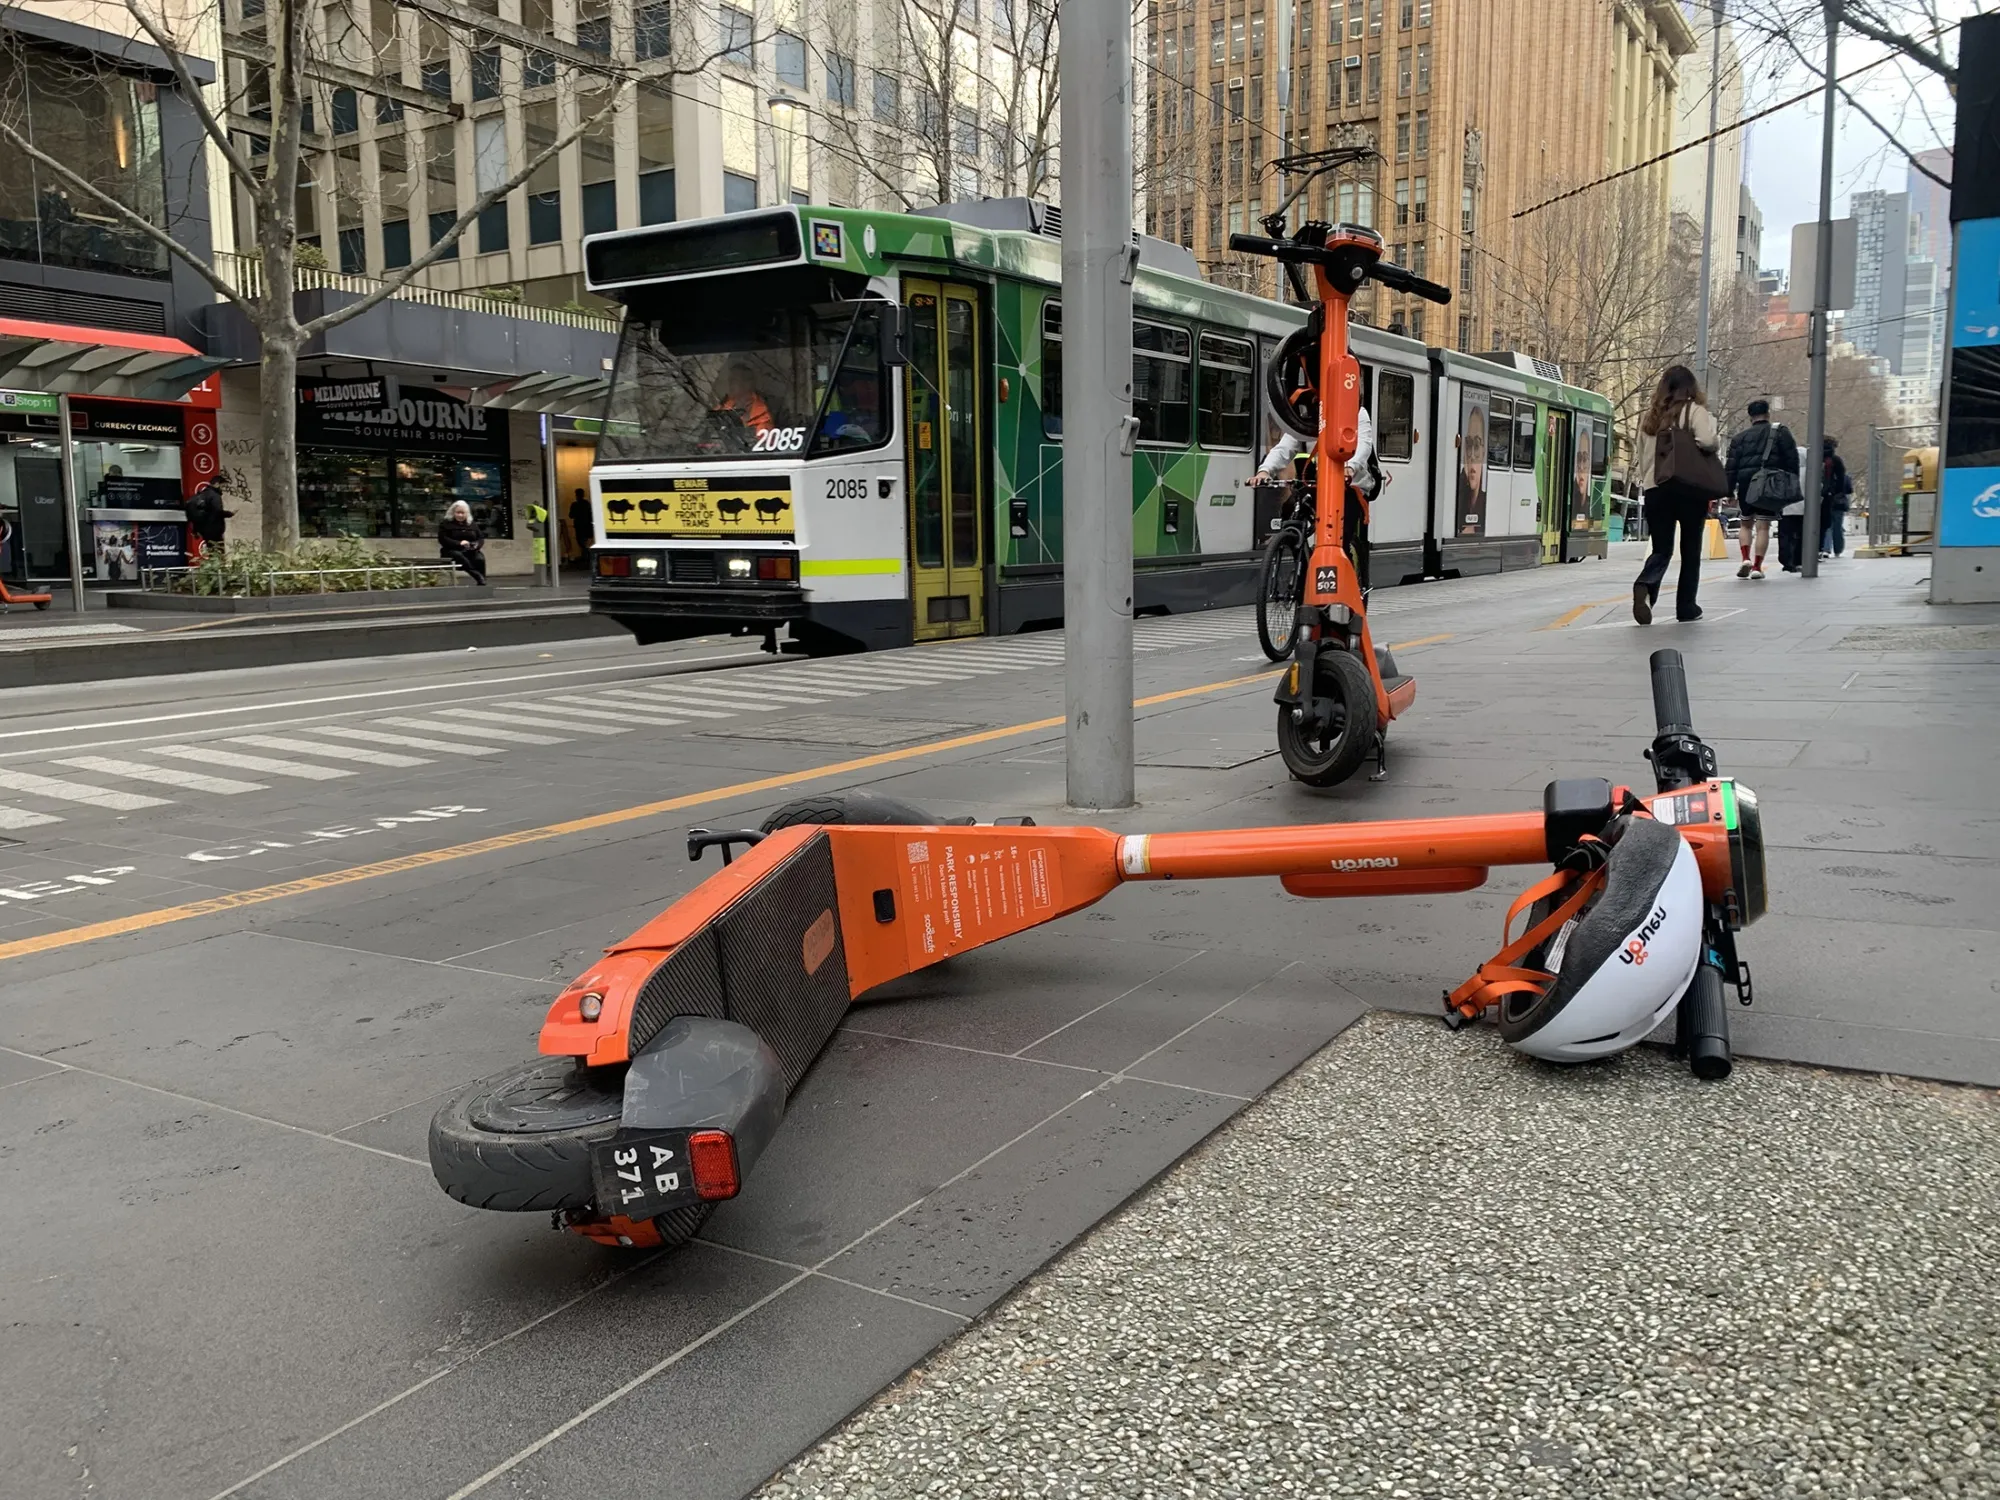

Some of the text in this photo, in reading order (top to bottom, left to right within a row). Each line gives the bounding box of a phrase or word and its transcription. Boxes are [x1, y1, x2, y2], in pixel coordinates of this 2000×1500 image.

[314, 382, 381, 402] MELBOURNE
[17, 396, 52, 407] Stop 11
[322, 398, 487, 431] LBOURNE
[94, 421, 178, 433] CURRENCY EXCHANGE
[354, 426, 462, 441] SOUVENIR SHOP
[752, 427, 806, 452] 2085
[673, 479, 709, 488] BEWARE
[826, 479, 867, 499] 2085
[34, 496, 55, 504] Uber
[680, 493, 705, 502] DON'T
[675, 510, 714, 519] FRONT OF
[681, 502, 707, 511] CUT IN
[681, 519, 709, 528] TRAMS
[1317, 570, 1336, 580] AA
[1317, 580, 1336, 590] 502
[181, 805, 487, 862] CLEAR
[1010, 845, 1018, 859] 16+
[1331, 856, 1399, 872] neuron
[180, 881, 311, 913] STAND
[312, 855, 433, 883] BEHIND
[1032, 859, 1040, 897] INFORMATION
[1037, 850, 1048, 904] IMPORTANT SAFETY
[945, 845, 963, 939] PARK RESPONSIBLY
[1619, 905, 1667, 965] neuron
[613, 1147, 645, 1206] 371
[649, 1145, 680, 1194] AB
